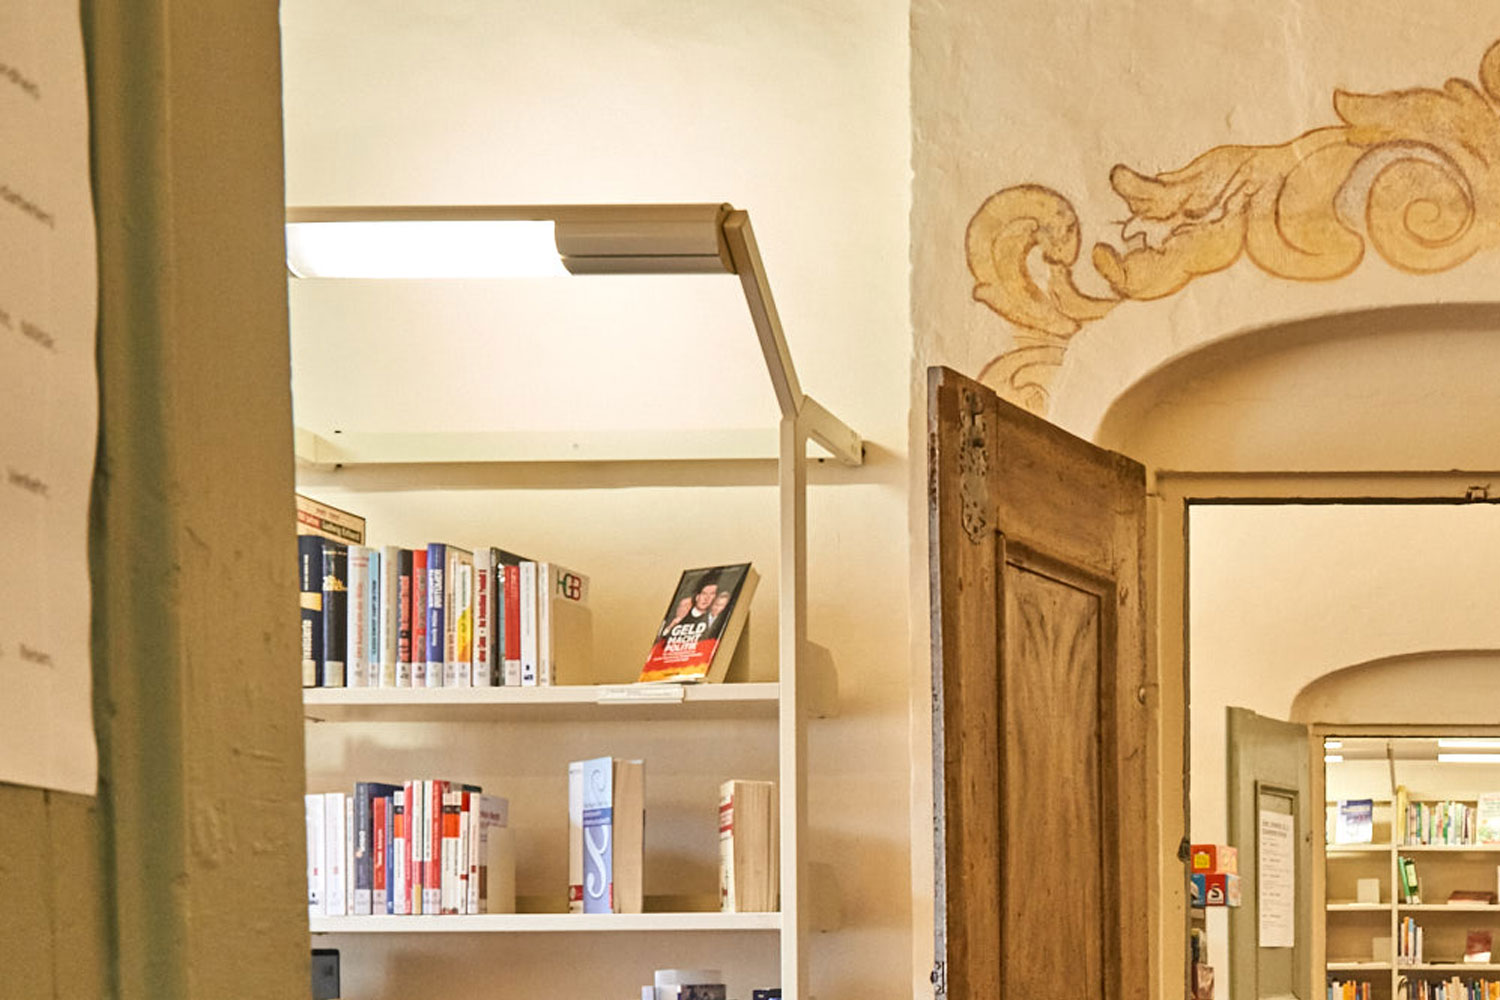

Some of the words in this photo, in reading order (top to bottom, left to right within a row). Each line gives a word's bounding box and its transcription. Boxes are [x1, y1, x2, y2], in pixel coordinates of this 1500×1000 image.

[671, 622, 706, 636] GELD
[668, 634, 701, 643] MACHT
[664, 642, 698, 652] POLITIK
